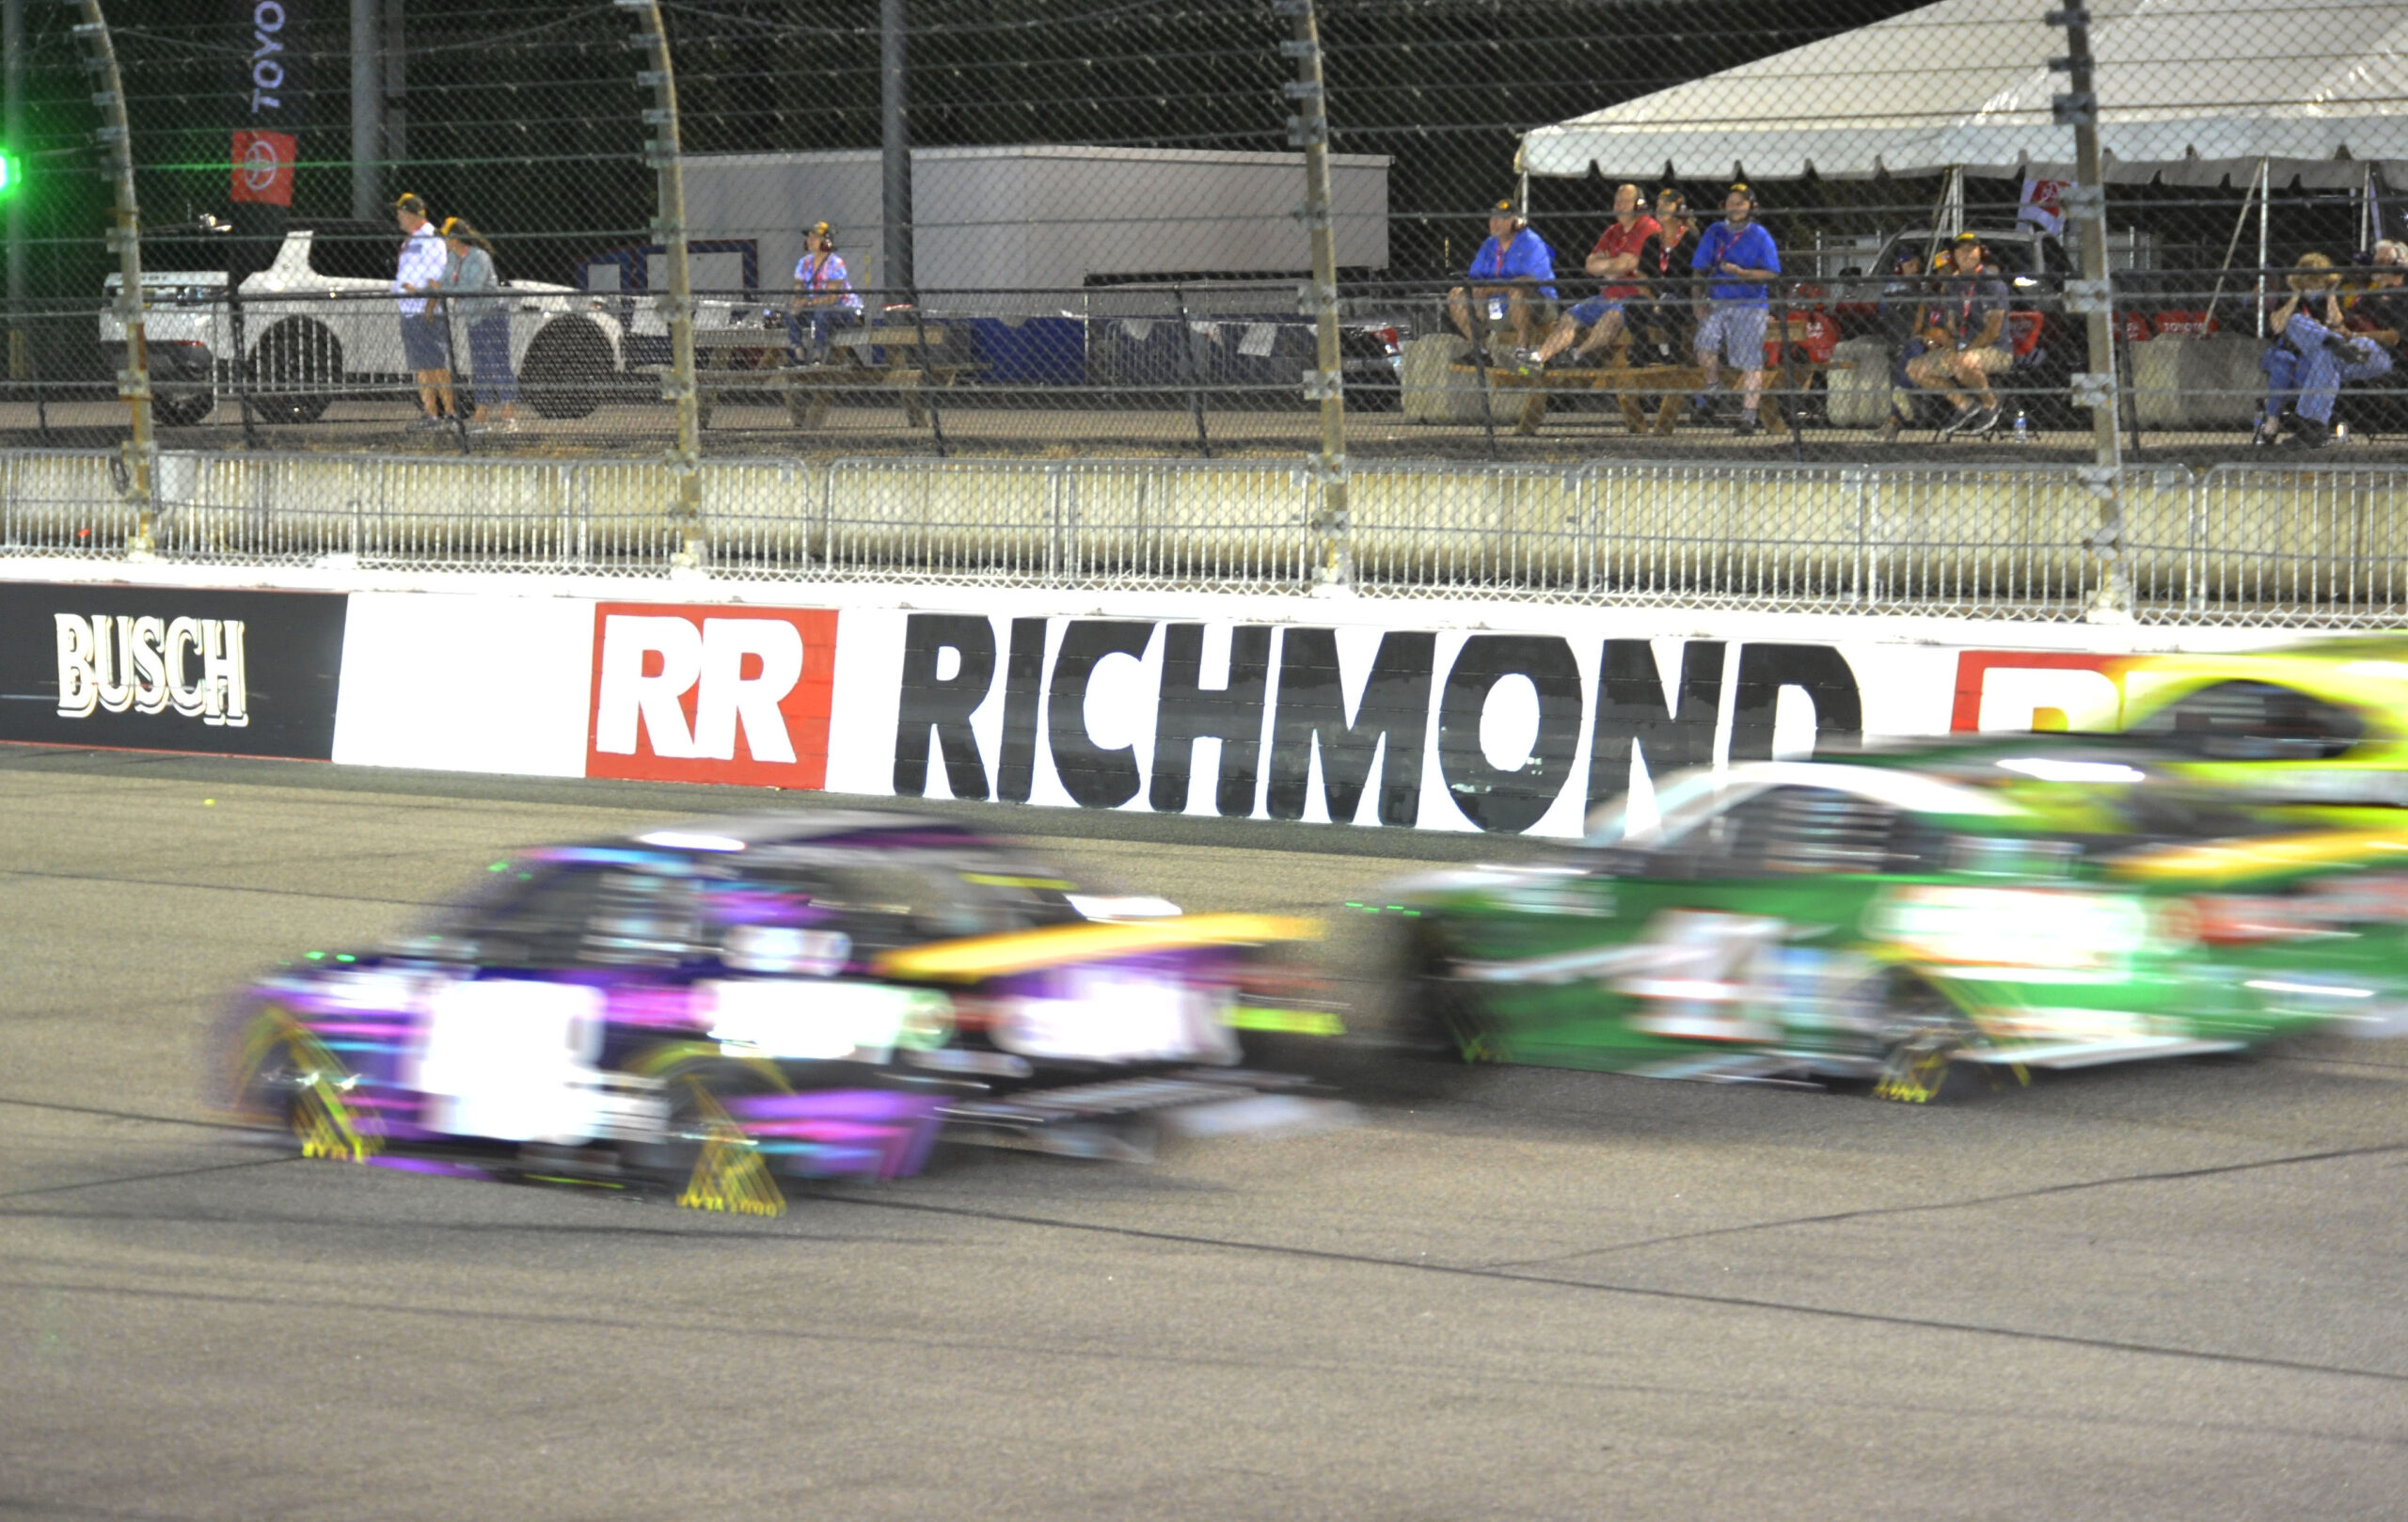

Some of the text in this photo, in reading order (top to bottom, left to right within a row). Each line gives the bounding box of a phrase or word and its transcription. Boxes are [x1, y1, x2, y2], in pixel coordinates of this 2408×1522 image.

[54, 612, 249, 728] BUSCH
[595, 613, 804, 764] RR
[892, 612, 1862, 835] RICHMOND
